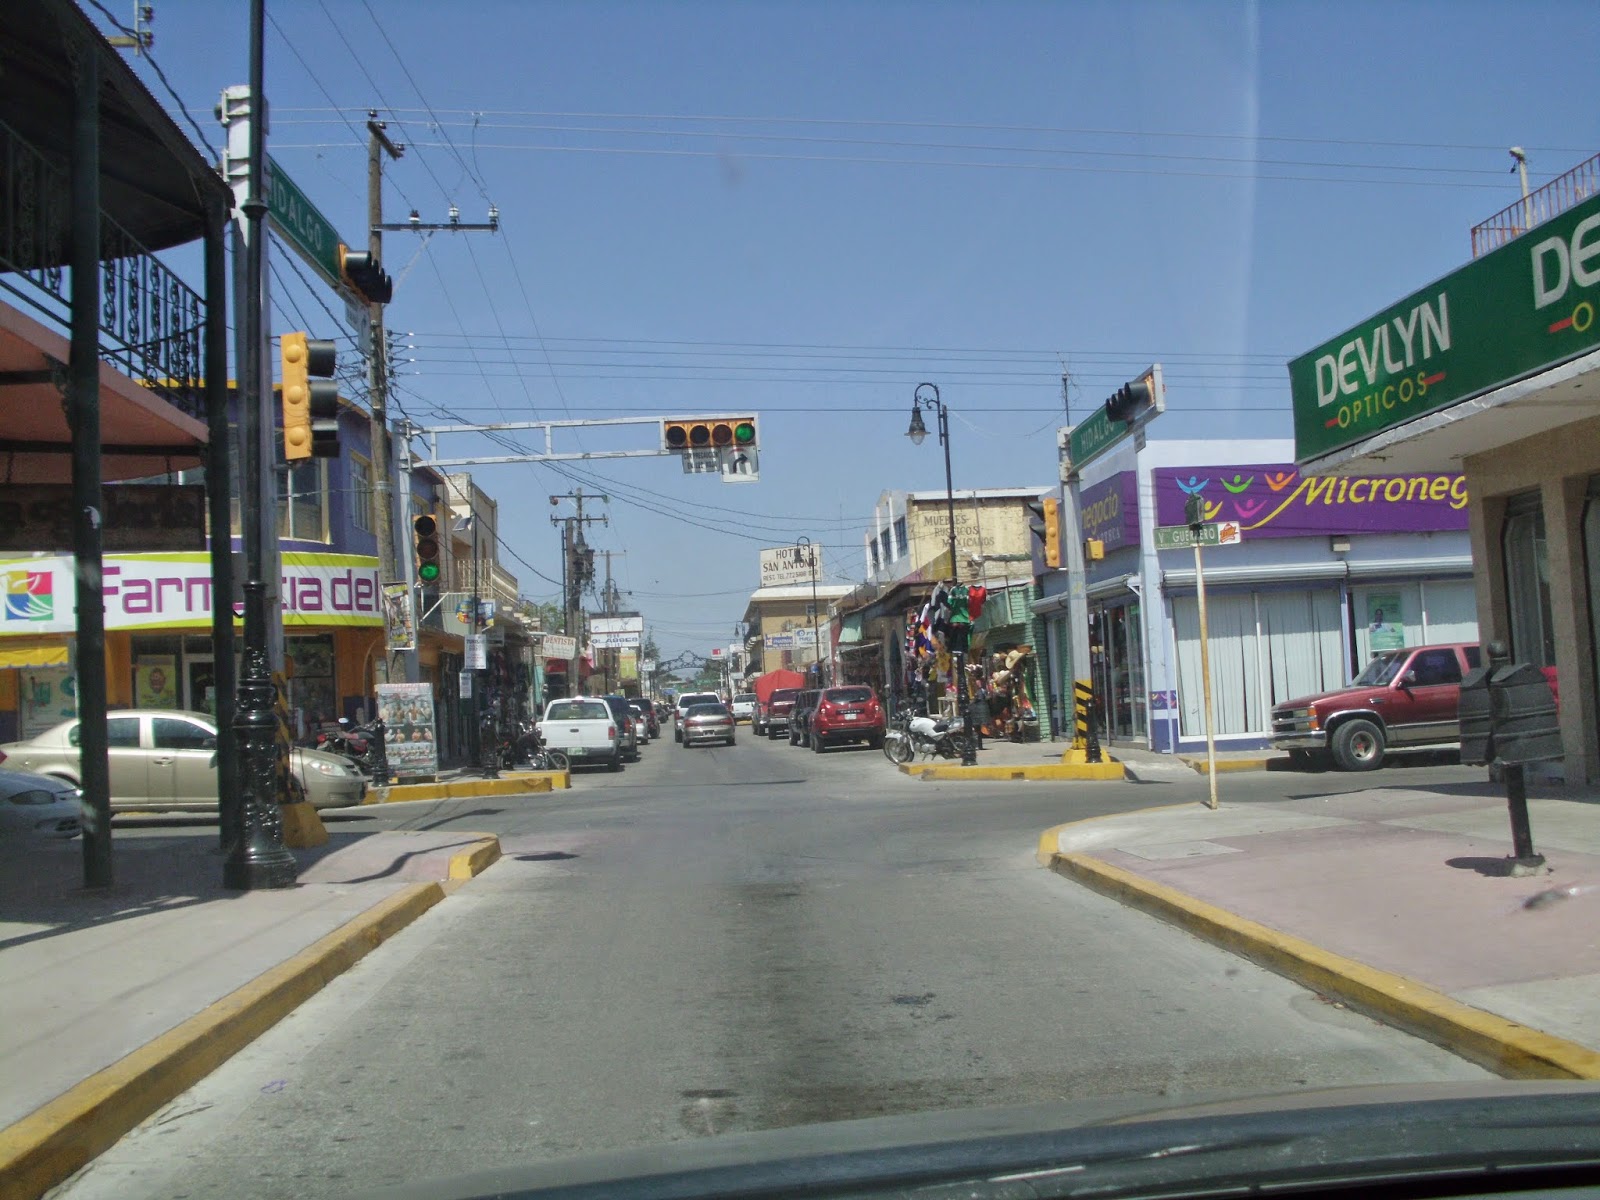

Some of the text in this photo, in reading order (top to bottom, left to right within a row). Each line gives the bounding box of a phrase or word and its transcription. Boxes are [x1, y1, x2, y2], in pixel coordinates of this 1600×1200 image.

[271, 176, 322, 250] IDALGO
[1315, 292, 1450, 408] DEVLYN
[1338, 371, 1427, 428] OPTICOS
[924, 514, 967, 526] MUEBES
[935, 526, 979, 537] RUSICOS
[1173, 528, 1215, 542] GUERERO
[942, 537, 995, 548] MXICANOS
[776, 548, 804, 559] HOT
[763, 557, 818, 572] SAN ANTONO
[102, 566, 380, 614] Farmia del
